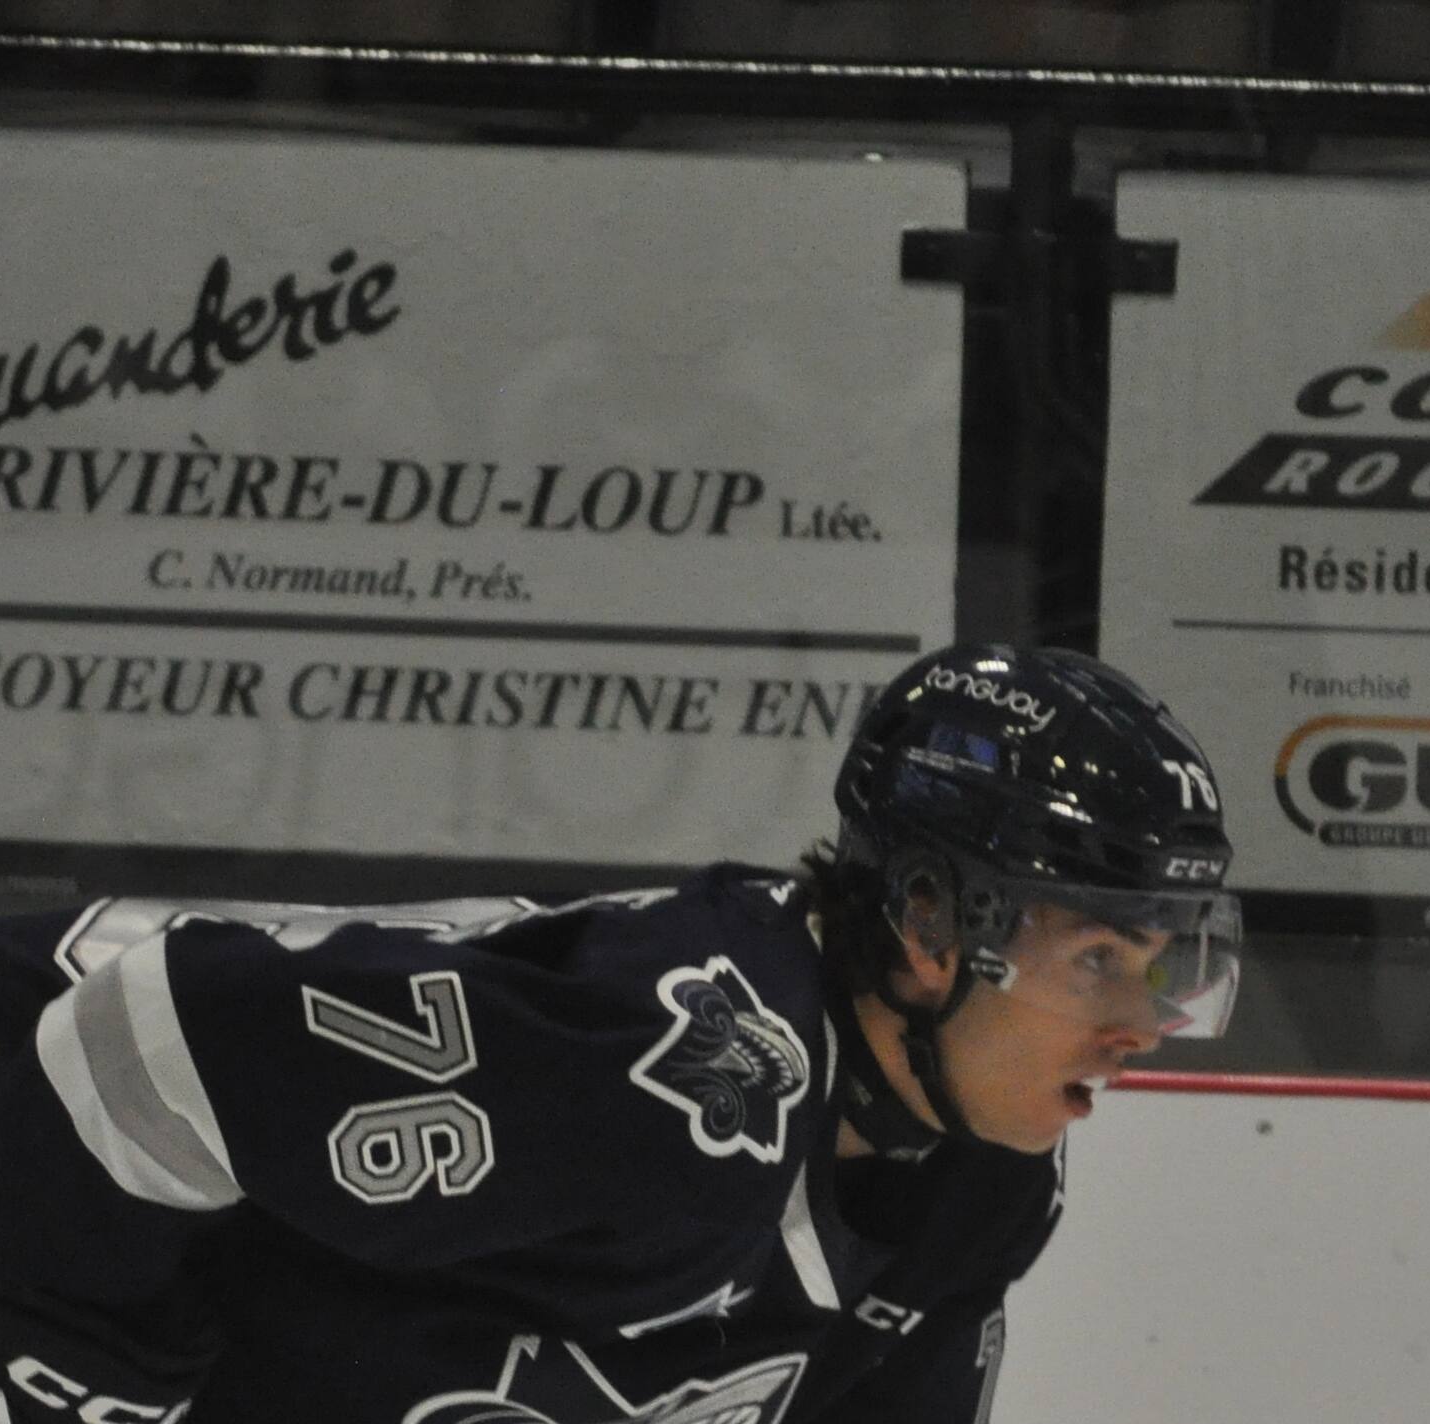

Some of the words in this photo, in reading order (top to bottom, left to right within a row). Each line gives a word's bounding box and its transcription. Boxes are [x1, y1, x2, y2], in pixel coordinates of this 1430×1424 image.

[778, 501, 883, 543] Ltée.
[147, 550, 193, 591] C.
[206, 552, 417, 602] Normand,
[430, 558, 533, 602] Prés.
[287, 662, 719, 735] CHRISTINE
[925, 663, 1057, 734] tanguay
[1288, 670, 1412, 700] Franchisé
[1161, 758, 1219, 812] 76
[300, 969, 495, 1206] 76
